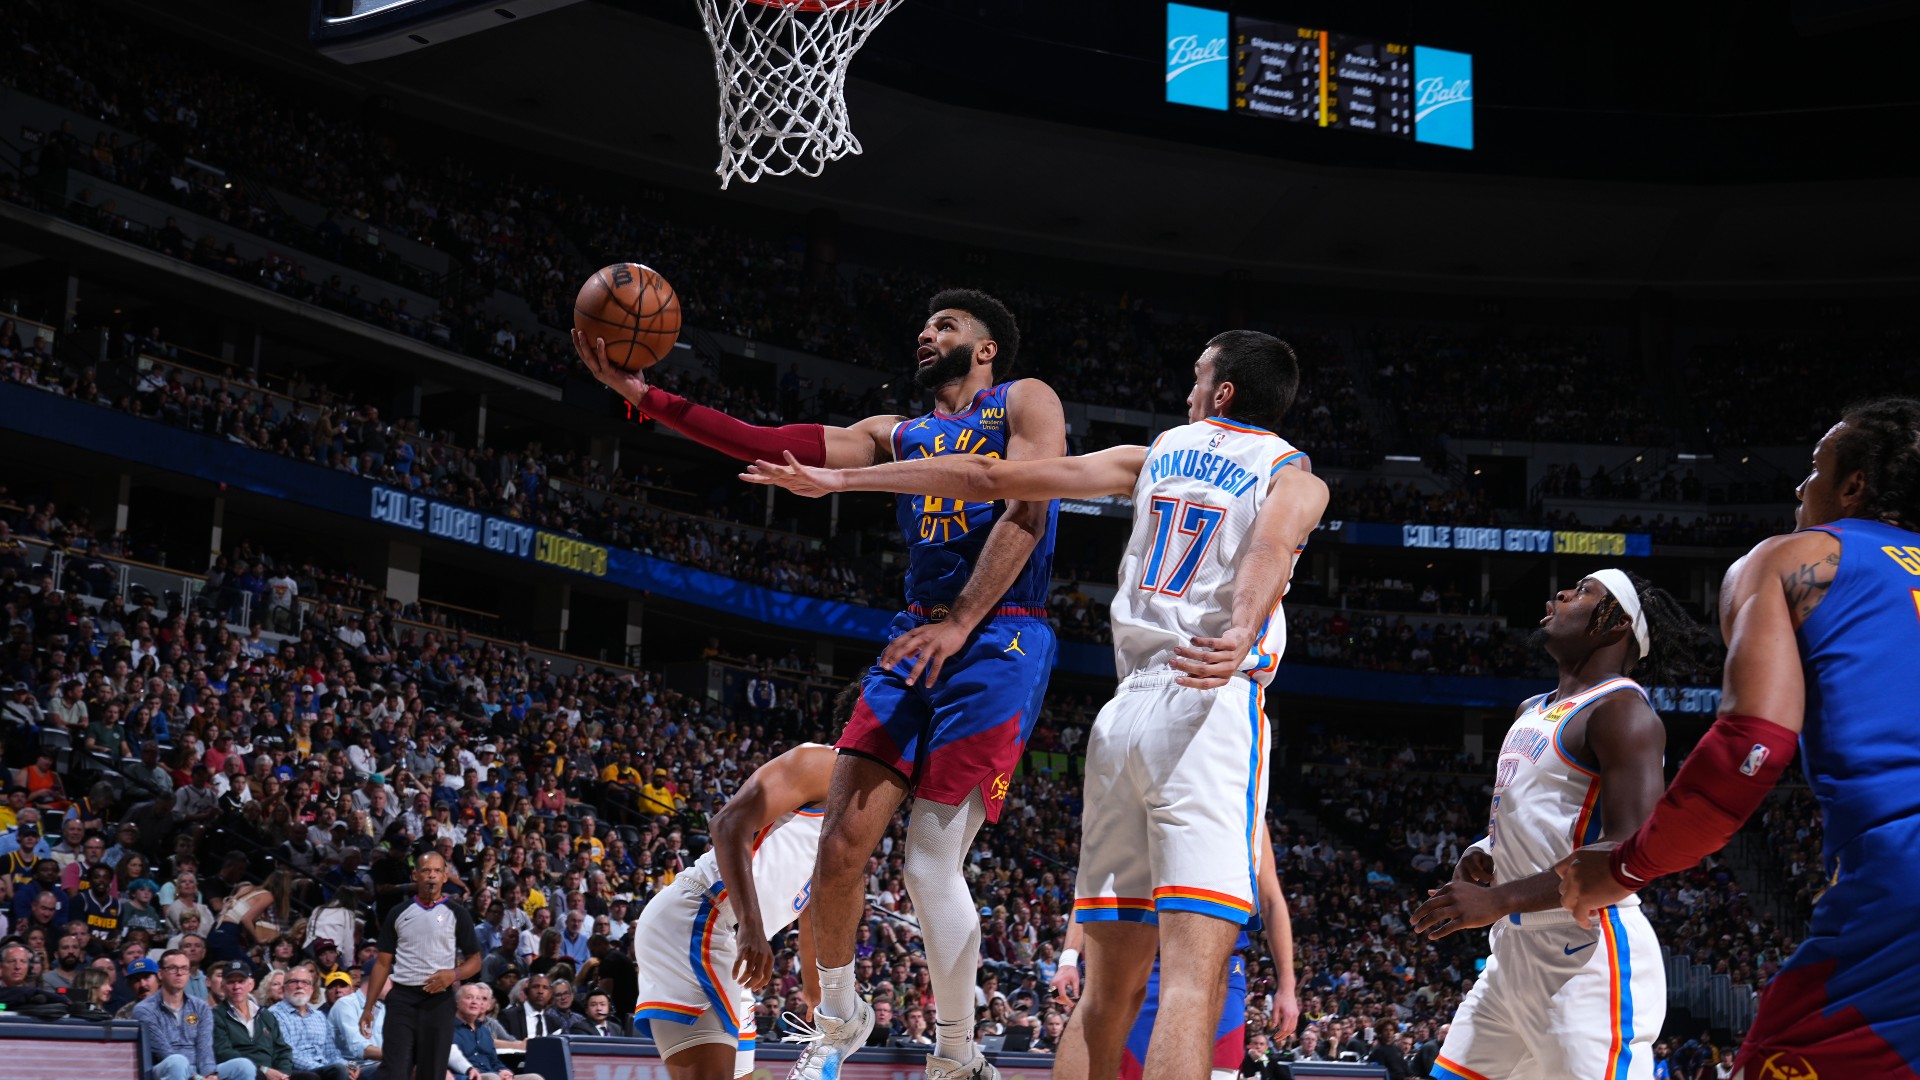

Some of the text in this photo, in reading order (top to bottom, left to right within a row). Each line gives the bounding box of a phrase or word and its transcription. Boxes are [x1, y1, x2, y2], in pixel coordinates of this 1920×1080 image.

[1167, 34, 1229, 67] Ball
[1415, 77, 1472, 108] Ball
[981, 407, 1005, 419] WU
[920, 510, 969, 543] CITY
[1138, 495, 1228, 598] 17
